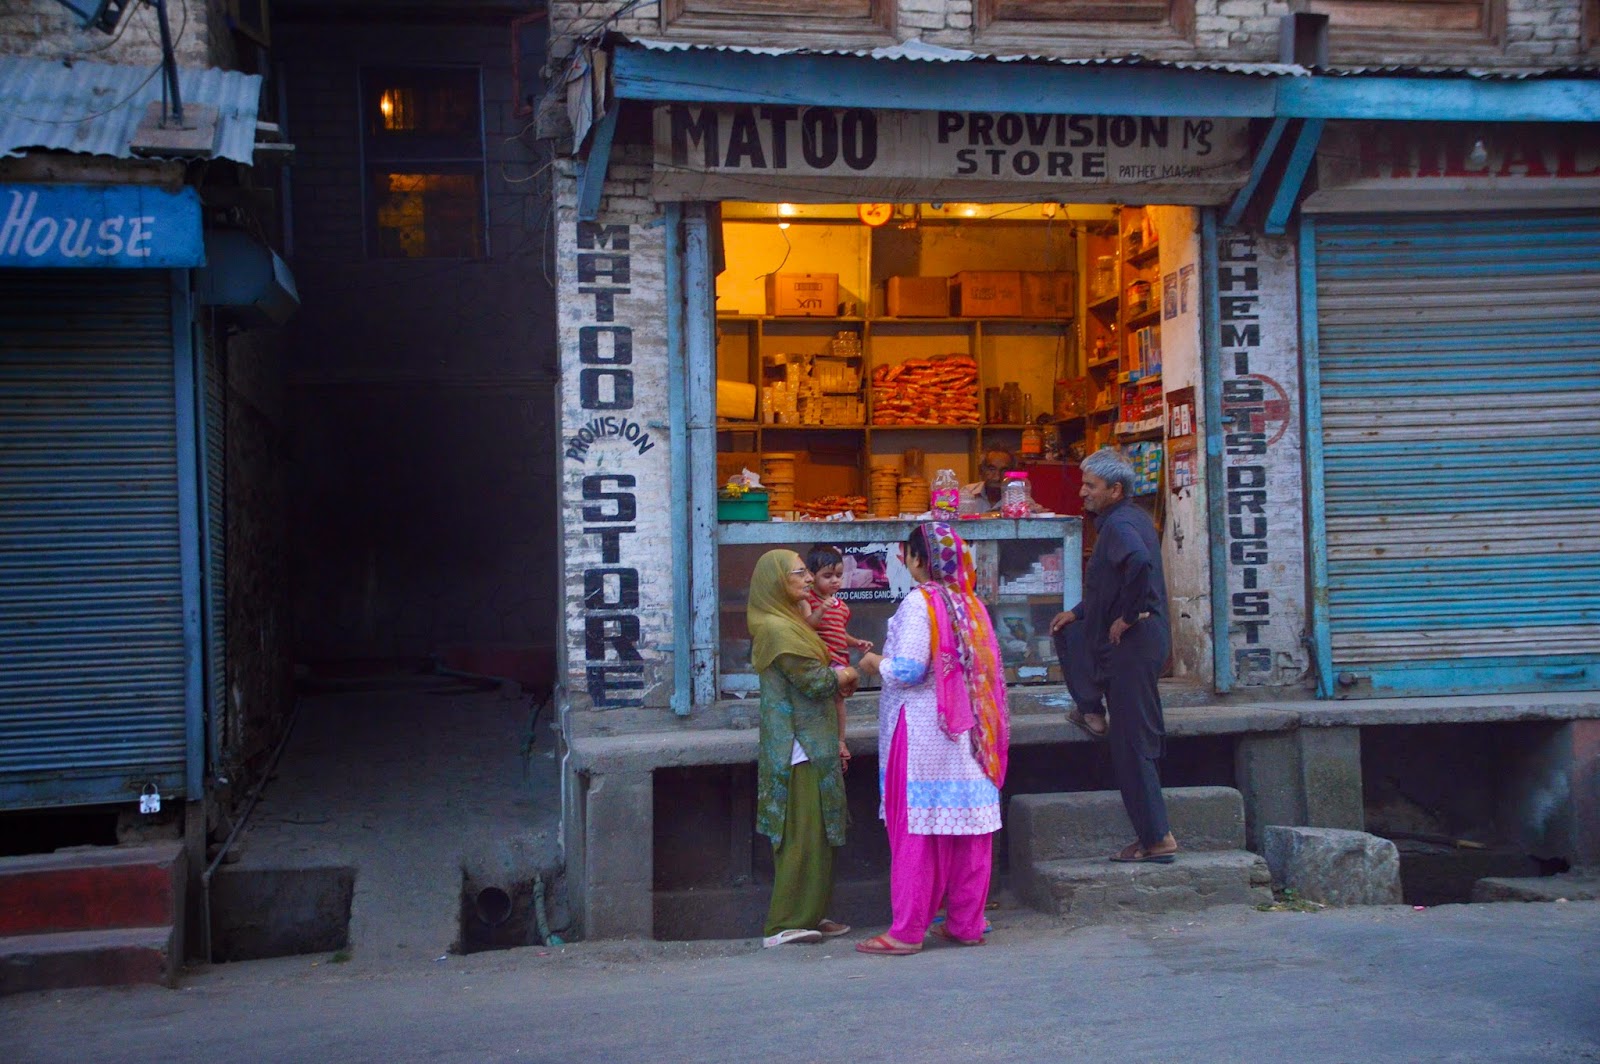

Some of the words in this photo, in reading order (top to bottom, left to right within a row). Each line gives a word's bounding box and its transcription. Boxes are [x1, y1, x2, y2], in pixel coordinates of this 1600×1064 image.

[671, 104, 878, 171] MATOO
[938, 112, 1168, 148] PROVISION
[956, 149, 1105, 177] STORE
[0, 190, 155, 258] HOUSE
[577, 225, 635, 409] MATOO
[1219, 239, 1267, 454] CHEMISTS
[566, 416, 654, 464] PROVISION
[582, 475, 644, 707] STORE
[850, 591, 873, 600] CAUSES
